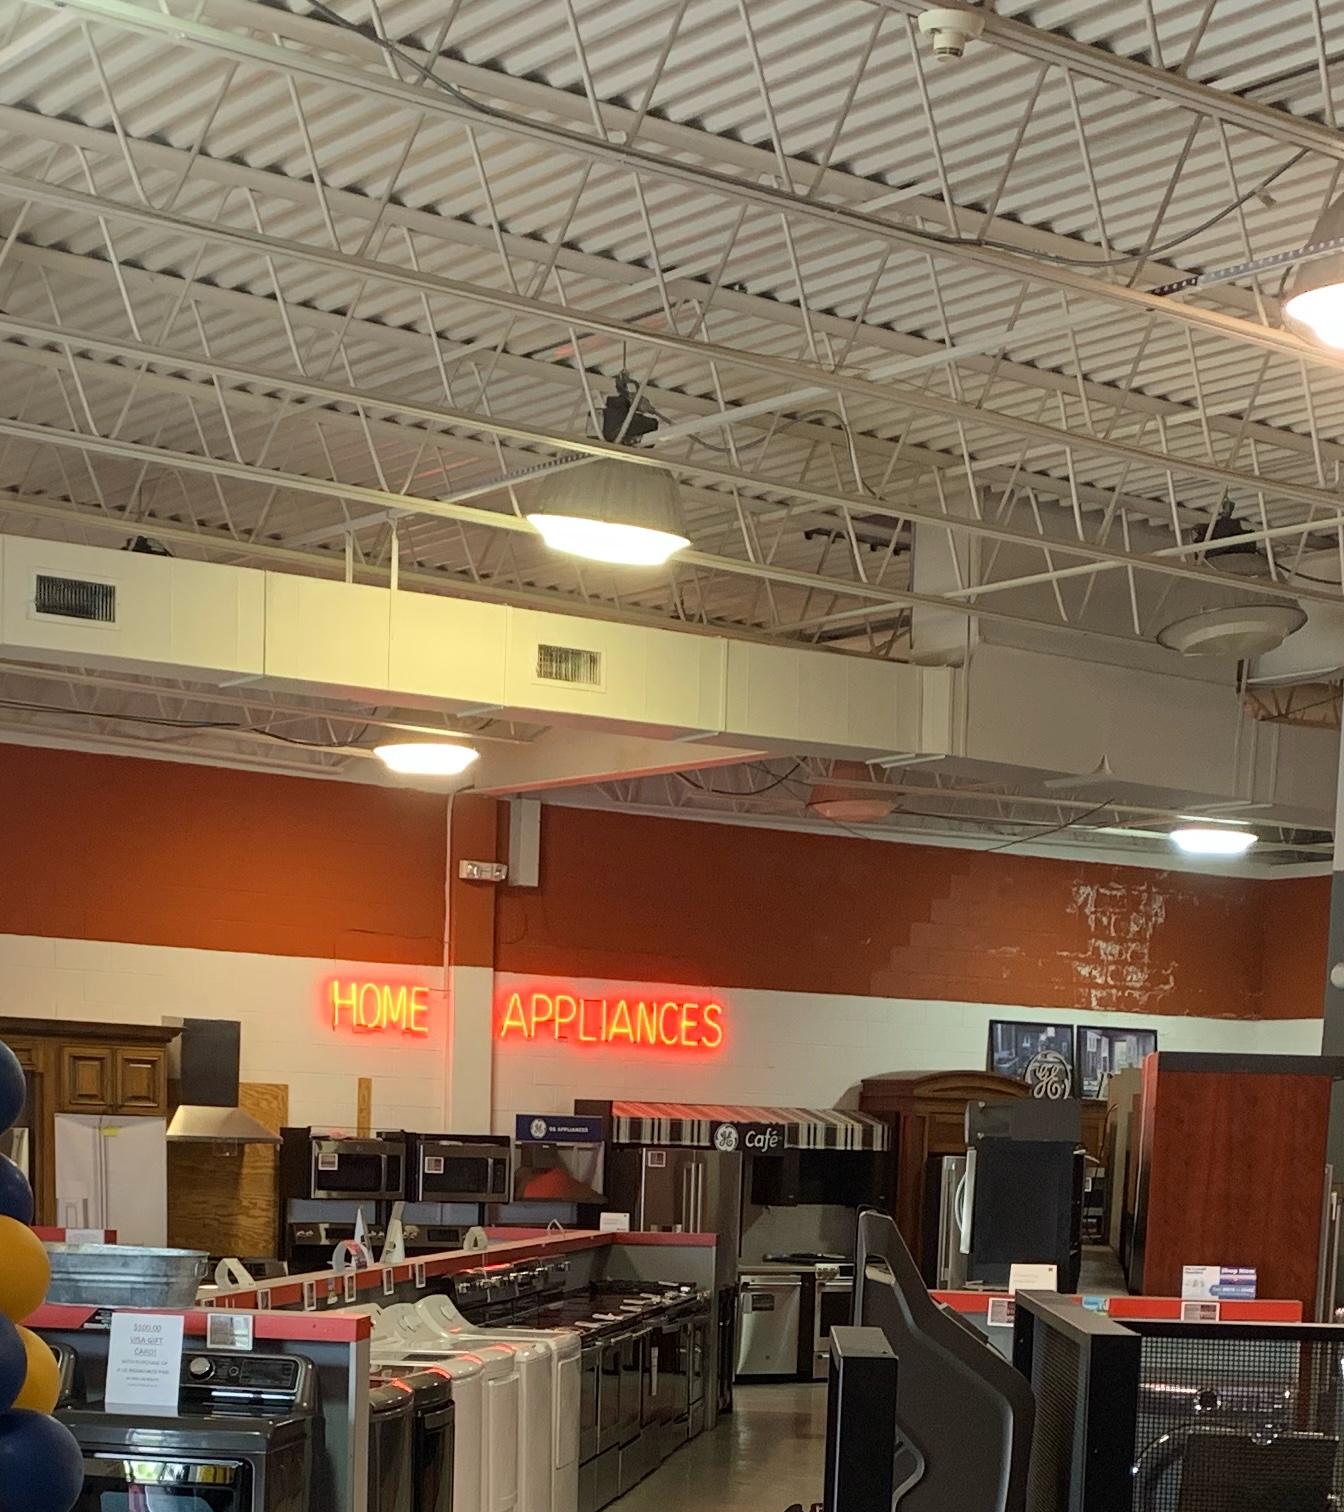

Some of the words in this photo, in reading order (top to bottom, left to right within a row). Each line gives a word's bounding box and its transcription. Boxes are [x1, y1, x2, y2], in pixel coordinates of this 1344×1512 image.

[332, 980, 430, 1032] HOME
[500, 992, 724, 1048] APPLIANCES
[745, 1127, 778, 1152] Café
